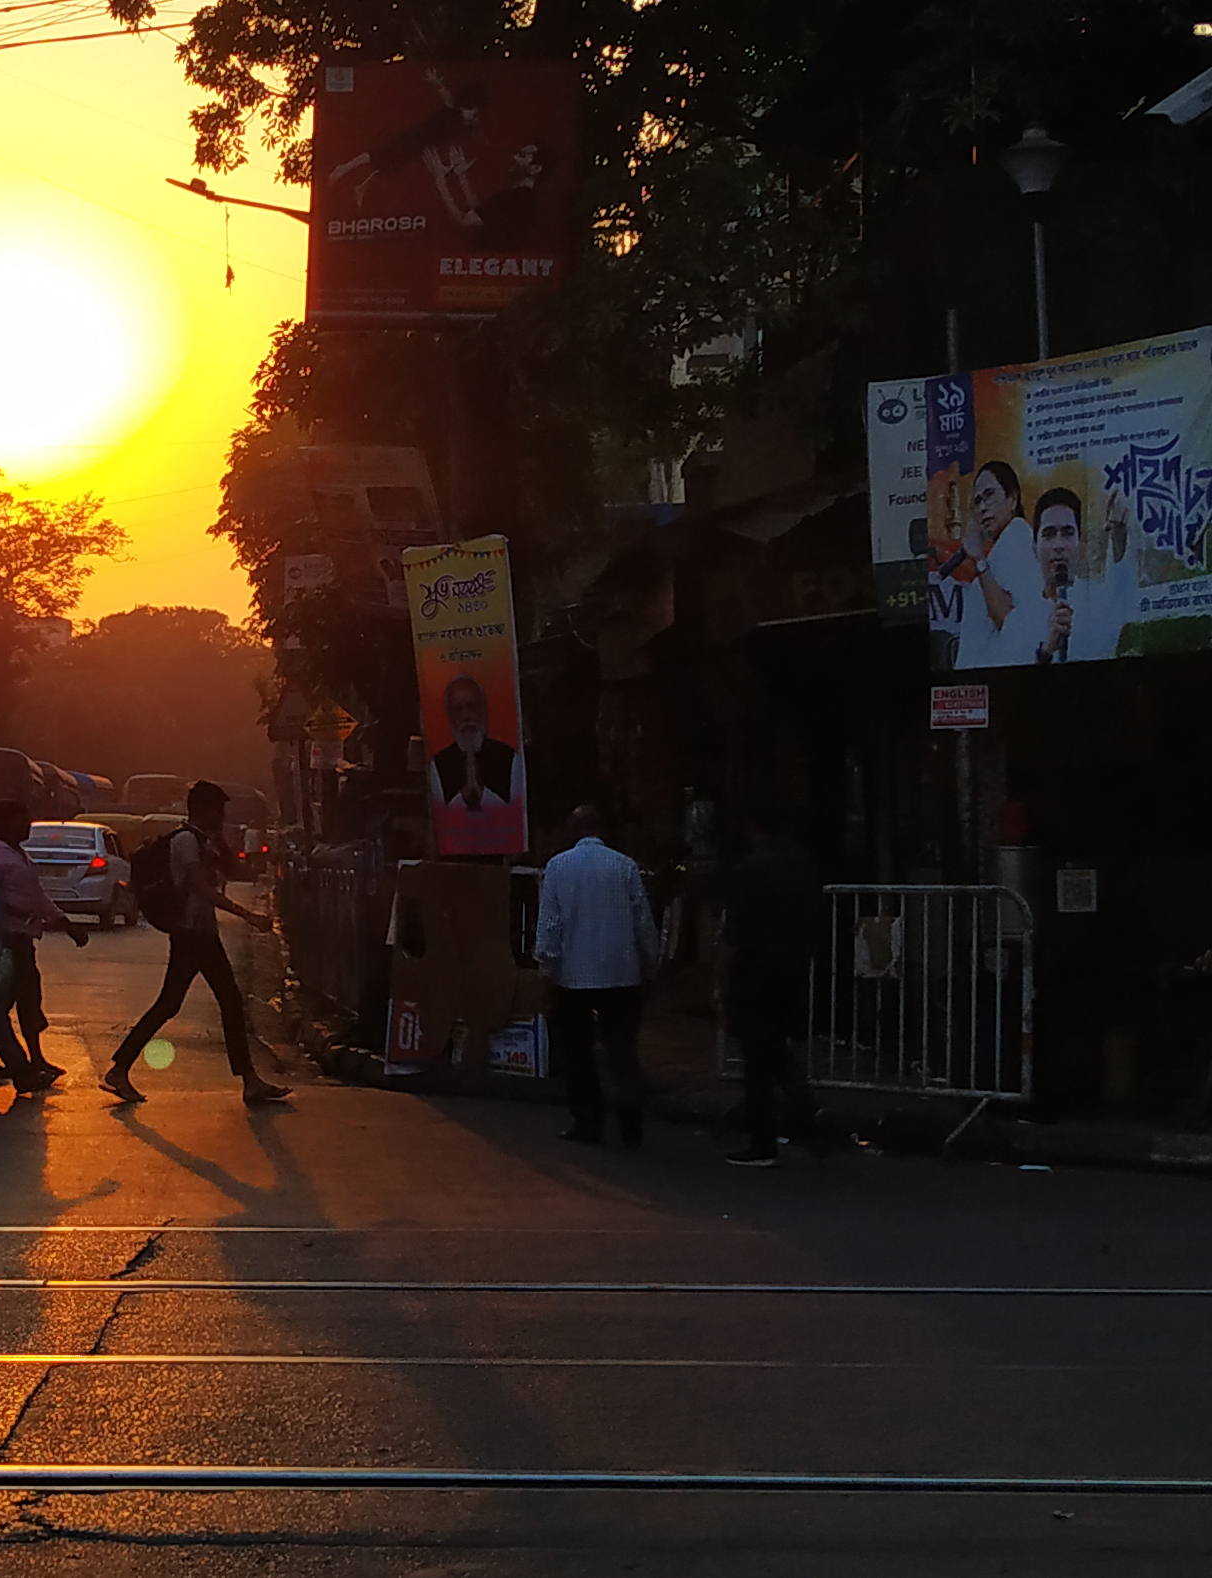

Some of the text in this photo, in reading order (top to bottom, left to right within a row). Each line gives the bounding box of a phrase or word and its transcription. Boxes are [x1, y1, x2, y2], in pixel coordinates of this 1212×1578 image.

[328, 215, 427, 235] BHAROSA
[439, 257, 554, 277] ELEGANT
[937, 382, 965, 409] ২৯
[939, 407, 965, 431] মার্চ
[900, 466, 922, 480] JEE
[934, 688, 985, 699] ENGLISH
